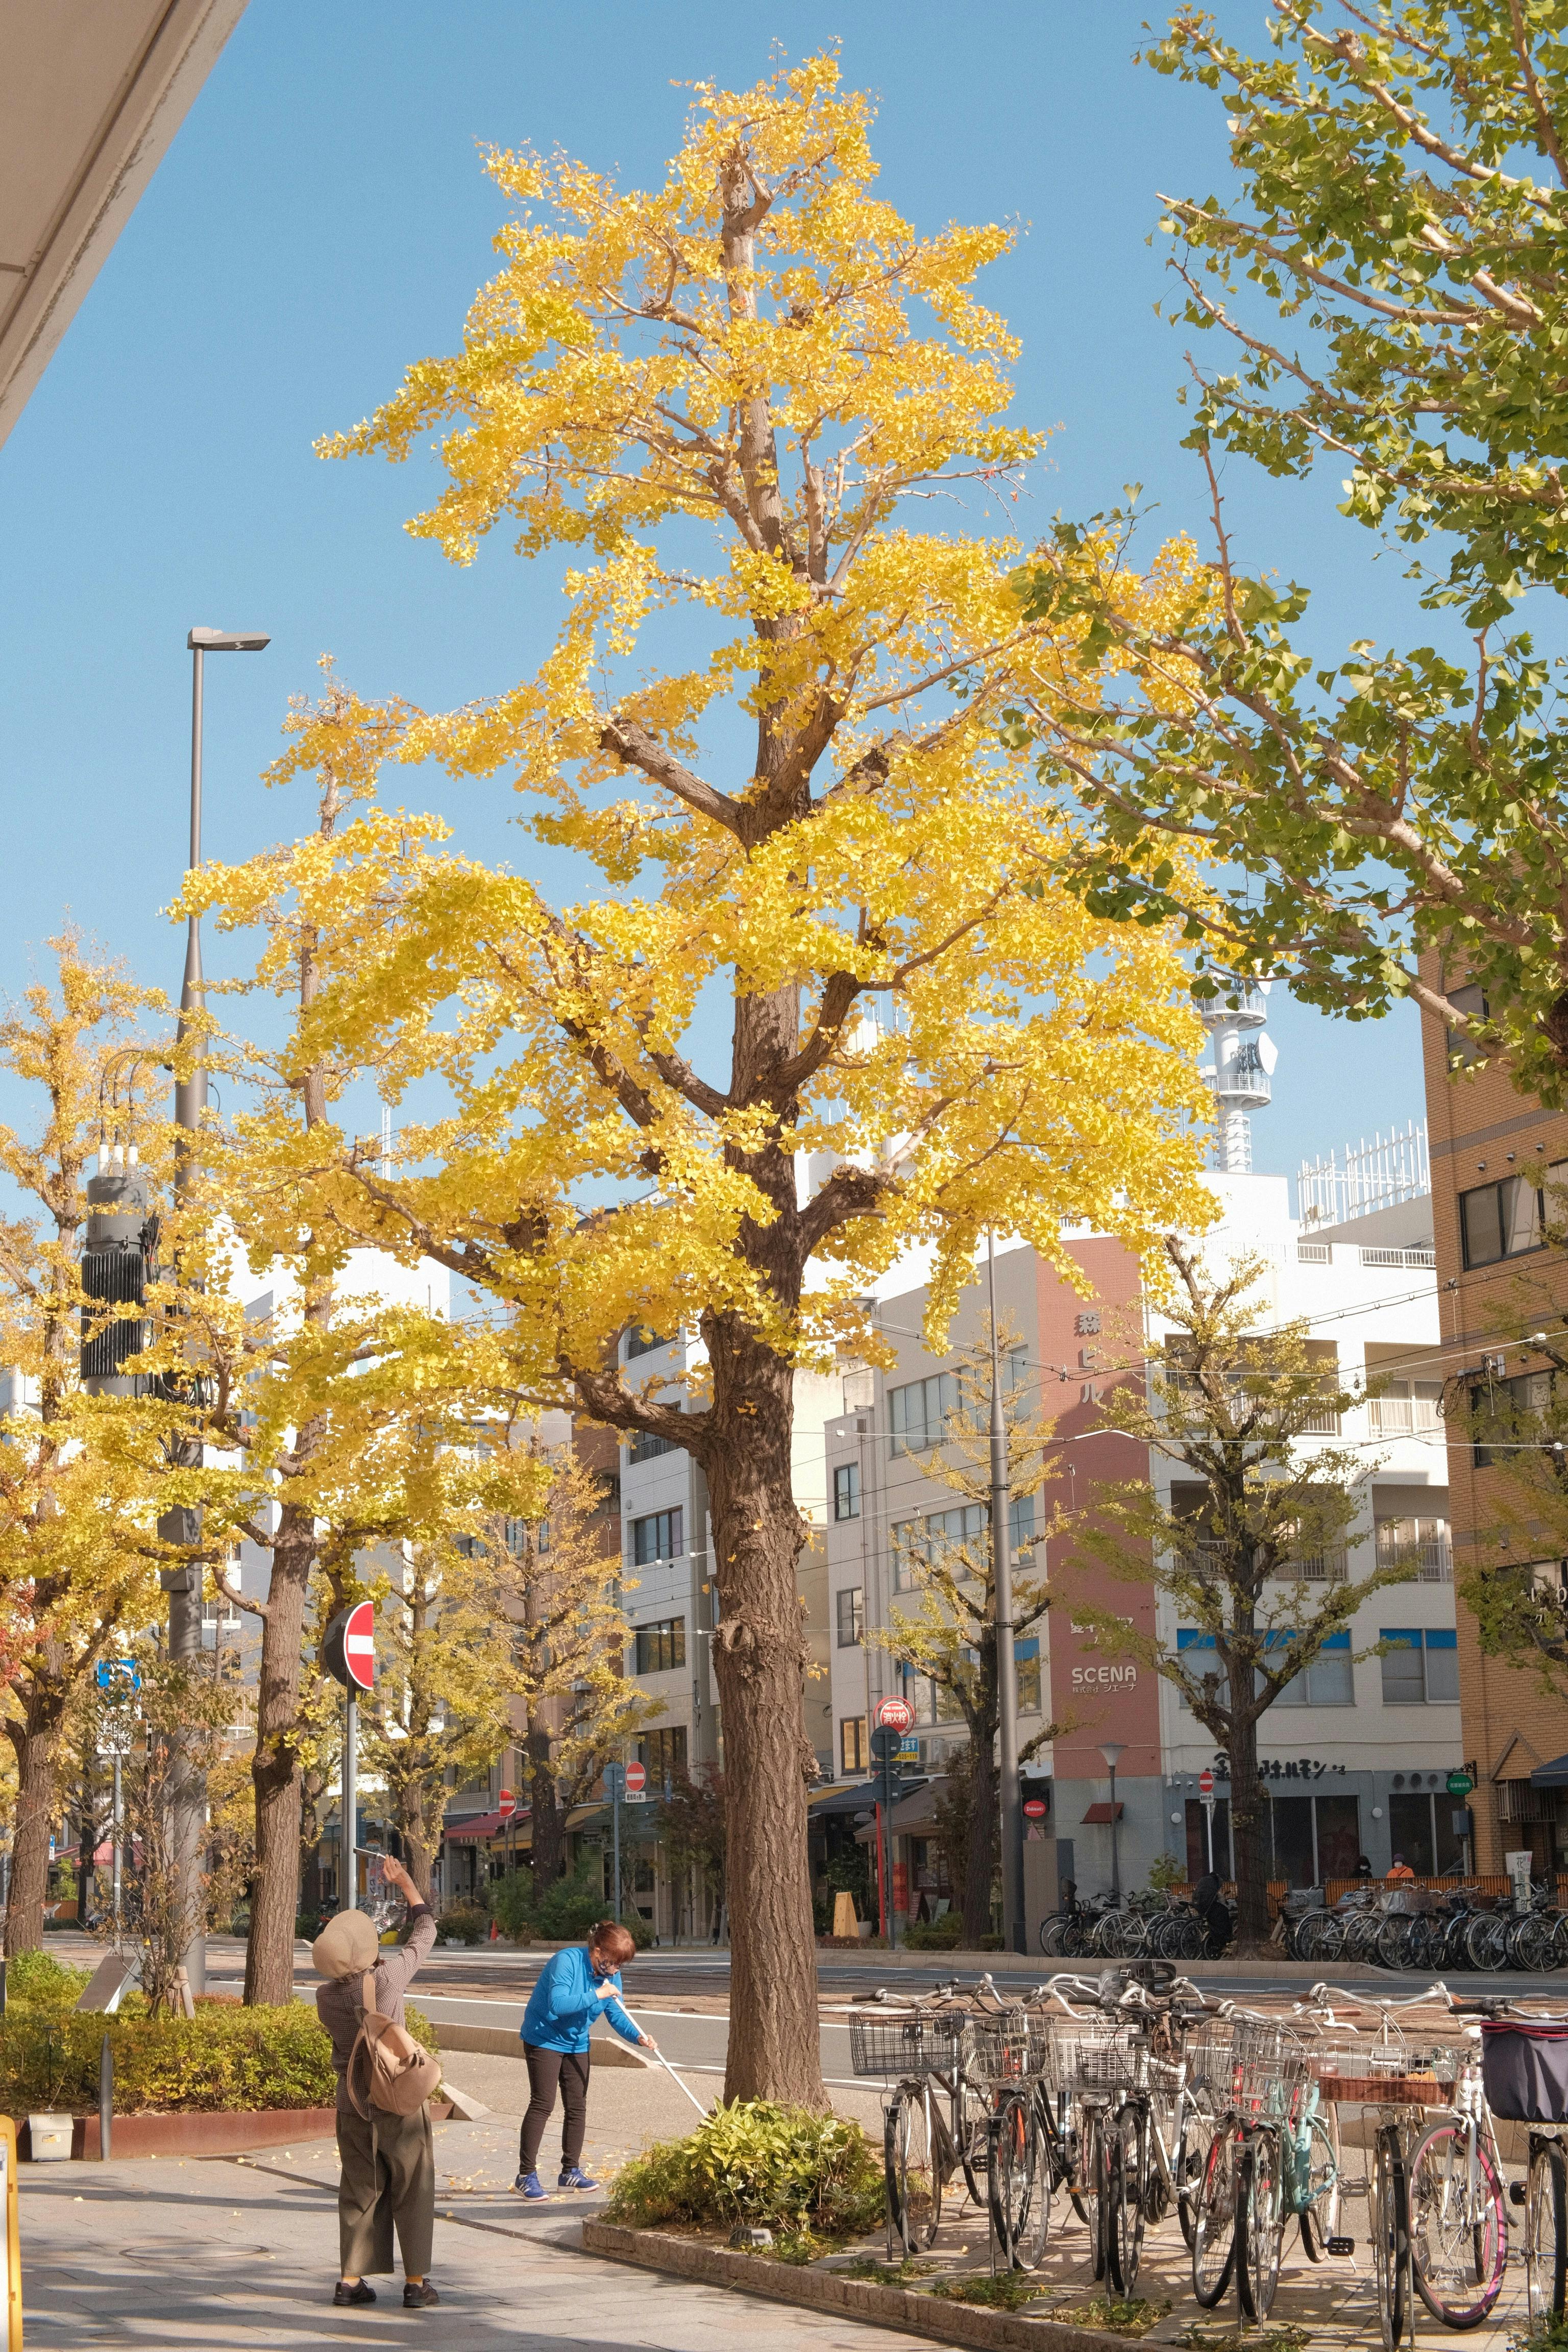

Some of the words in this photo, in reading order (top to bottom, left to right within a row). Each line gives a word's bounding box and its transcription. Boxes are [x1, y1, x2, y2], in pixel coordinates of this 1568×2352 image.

[1072, 1665, 1137, 1684] SCENA
[883, 1711, 906, 1724] 消火栓
